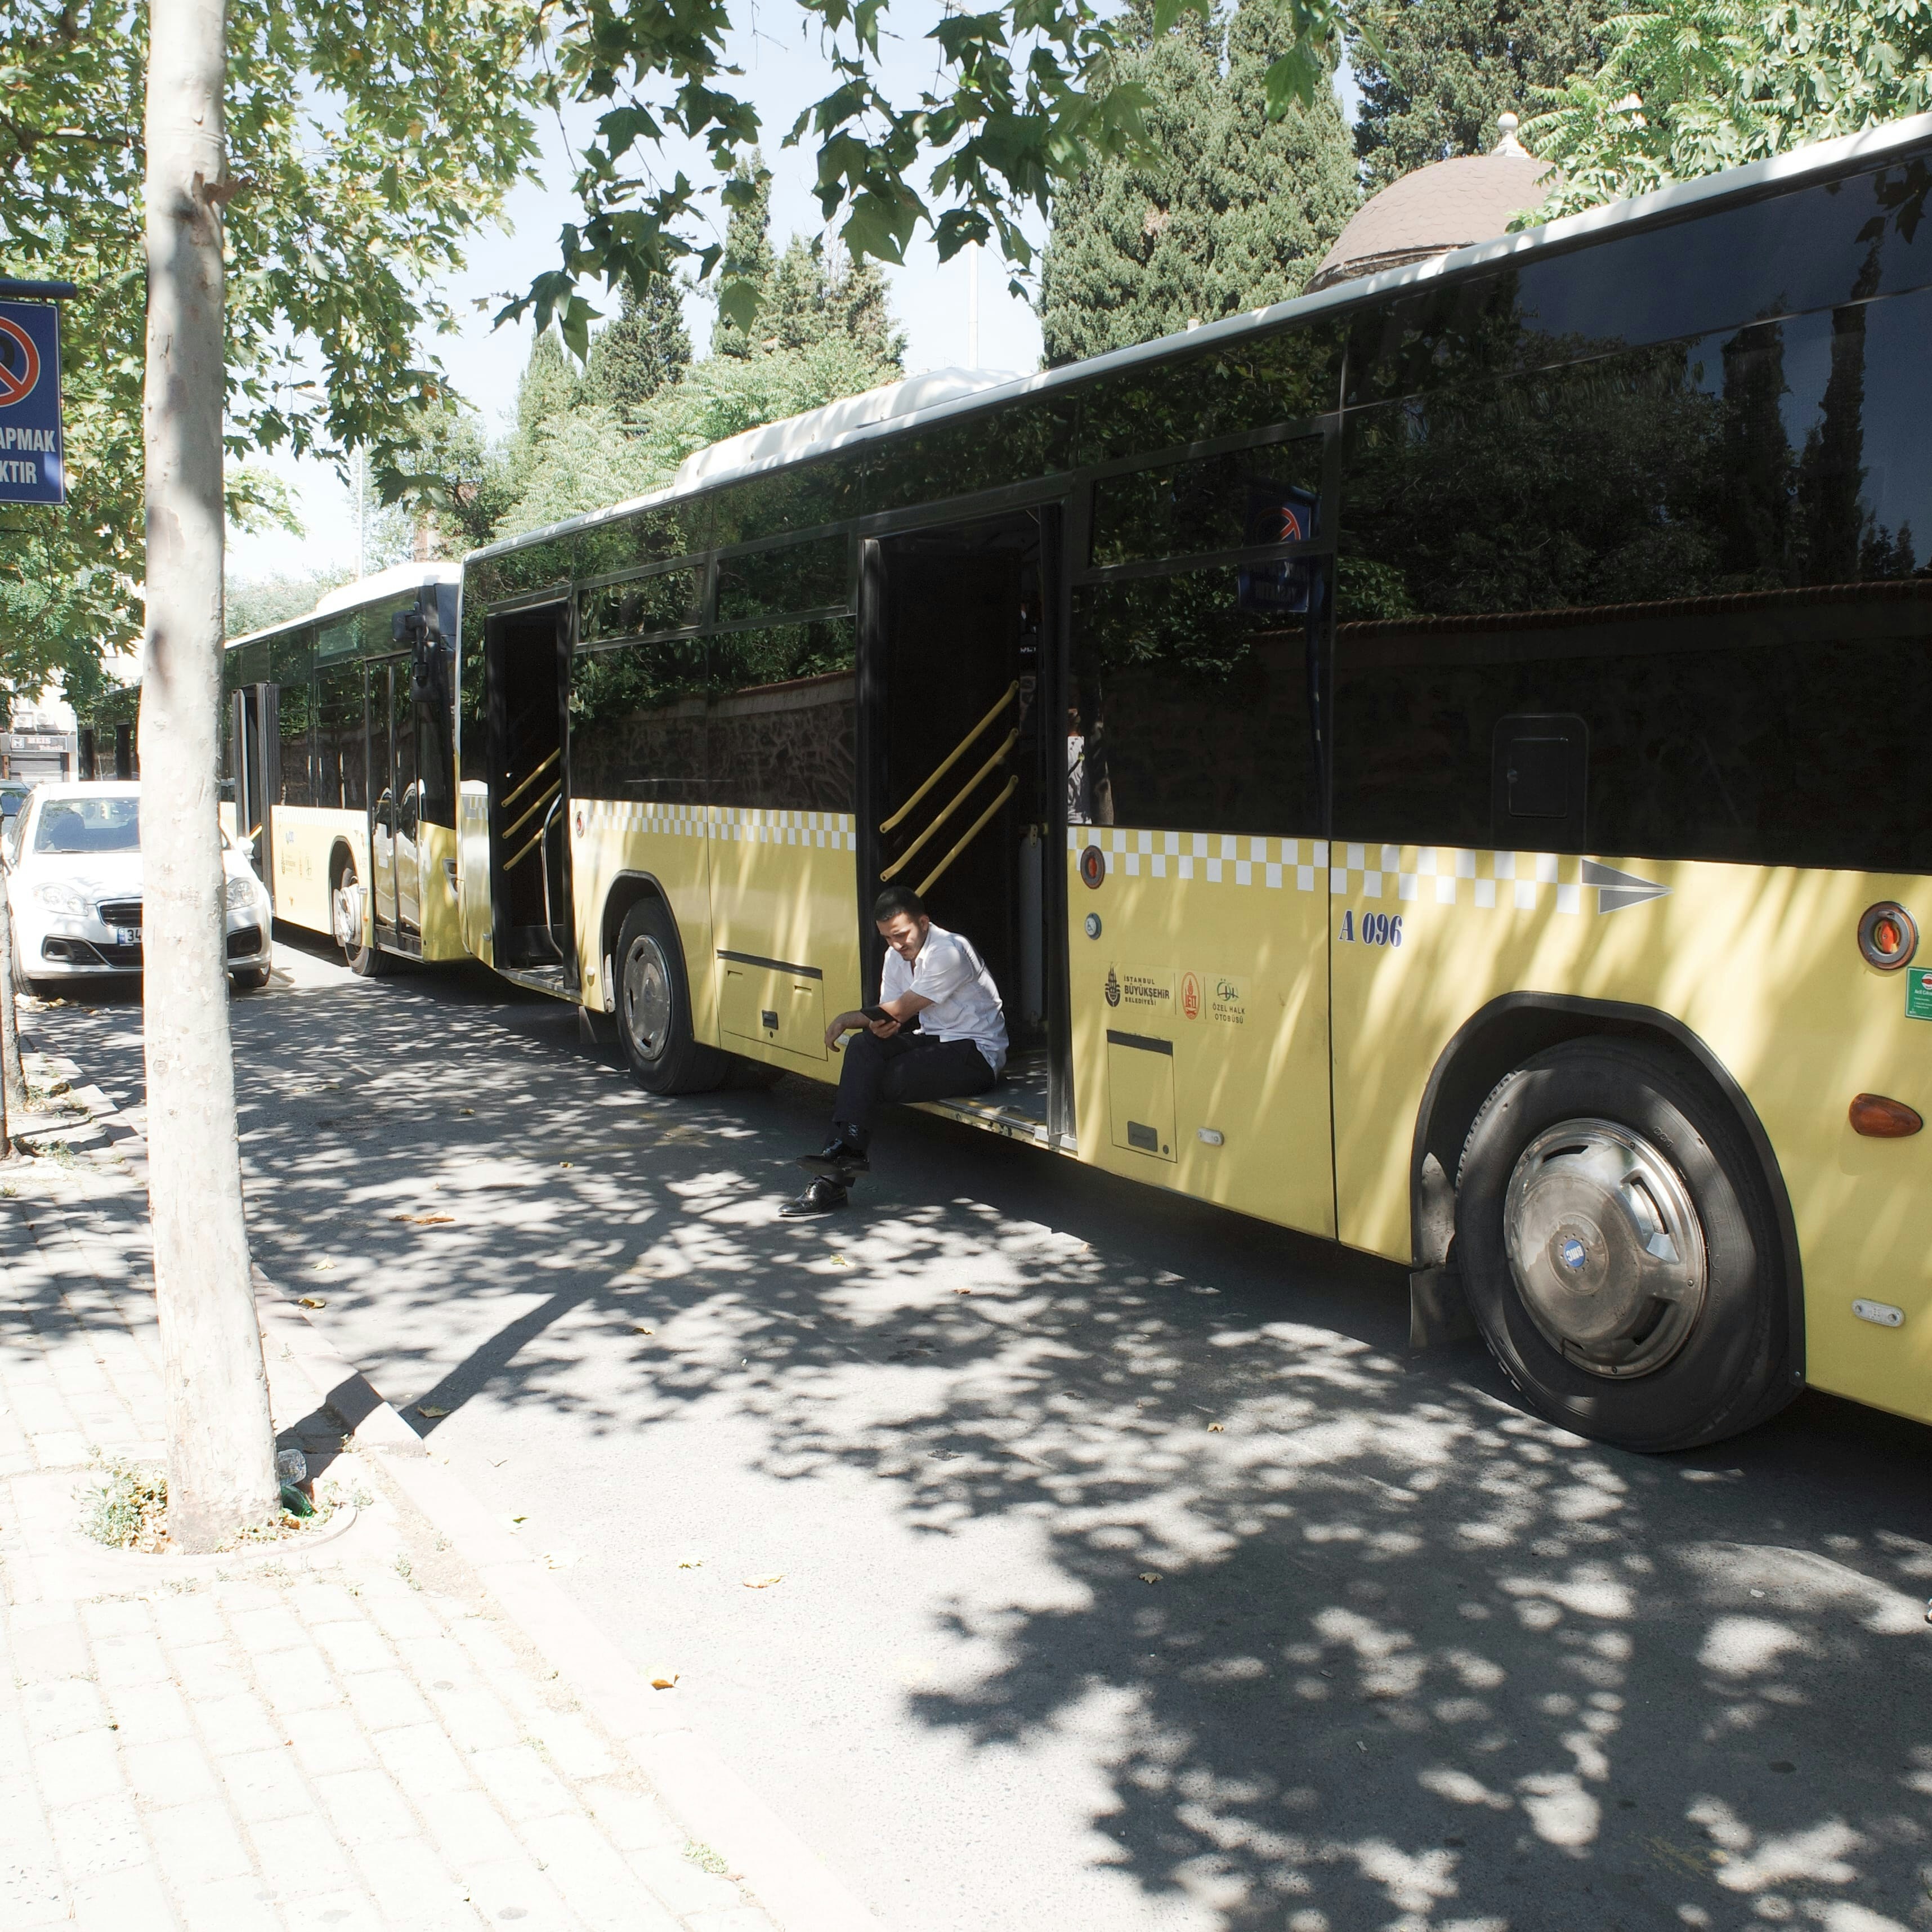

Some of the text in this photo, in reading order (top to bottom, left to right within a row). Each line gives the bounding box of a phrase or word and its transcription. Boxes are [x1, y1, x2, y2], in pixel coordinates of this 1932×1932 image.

[1338, 909, 1403, 947] A 096
[127, 929, 141, 942] 34
[1124, 974, 1155, 985] İSTANBUL
[1125, 996, 1156, 1005] BELEDİYESİ
[1213, 1002, 1245, 1014] ÖZEL HALK
[1214, 1013, 1244, 1023] OTOBÜSÜ
[1566, 1245, 1584, 1262] BMC
